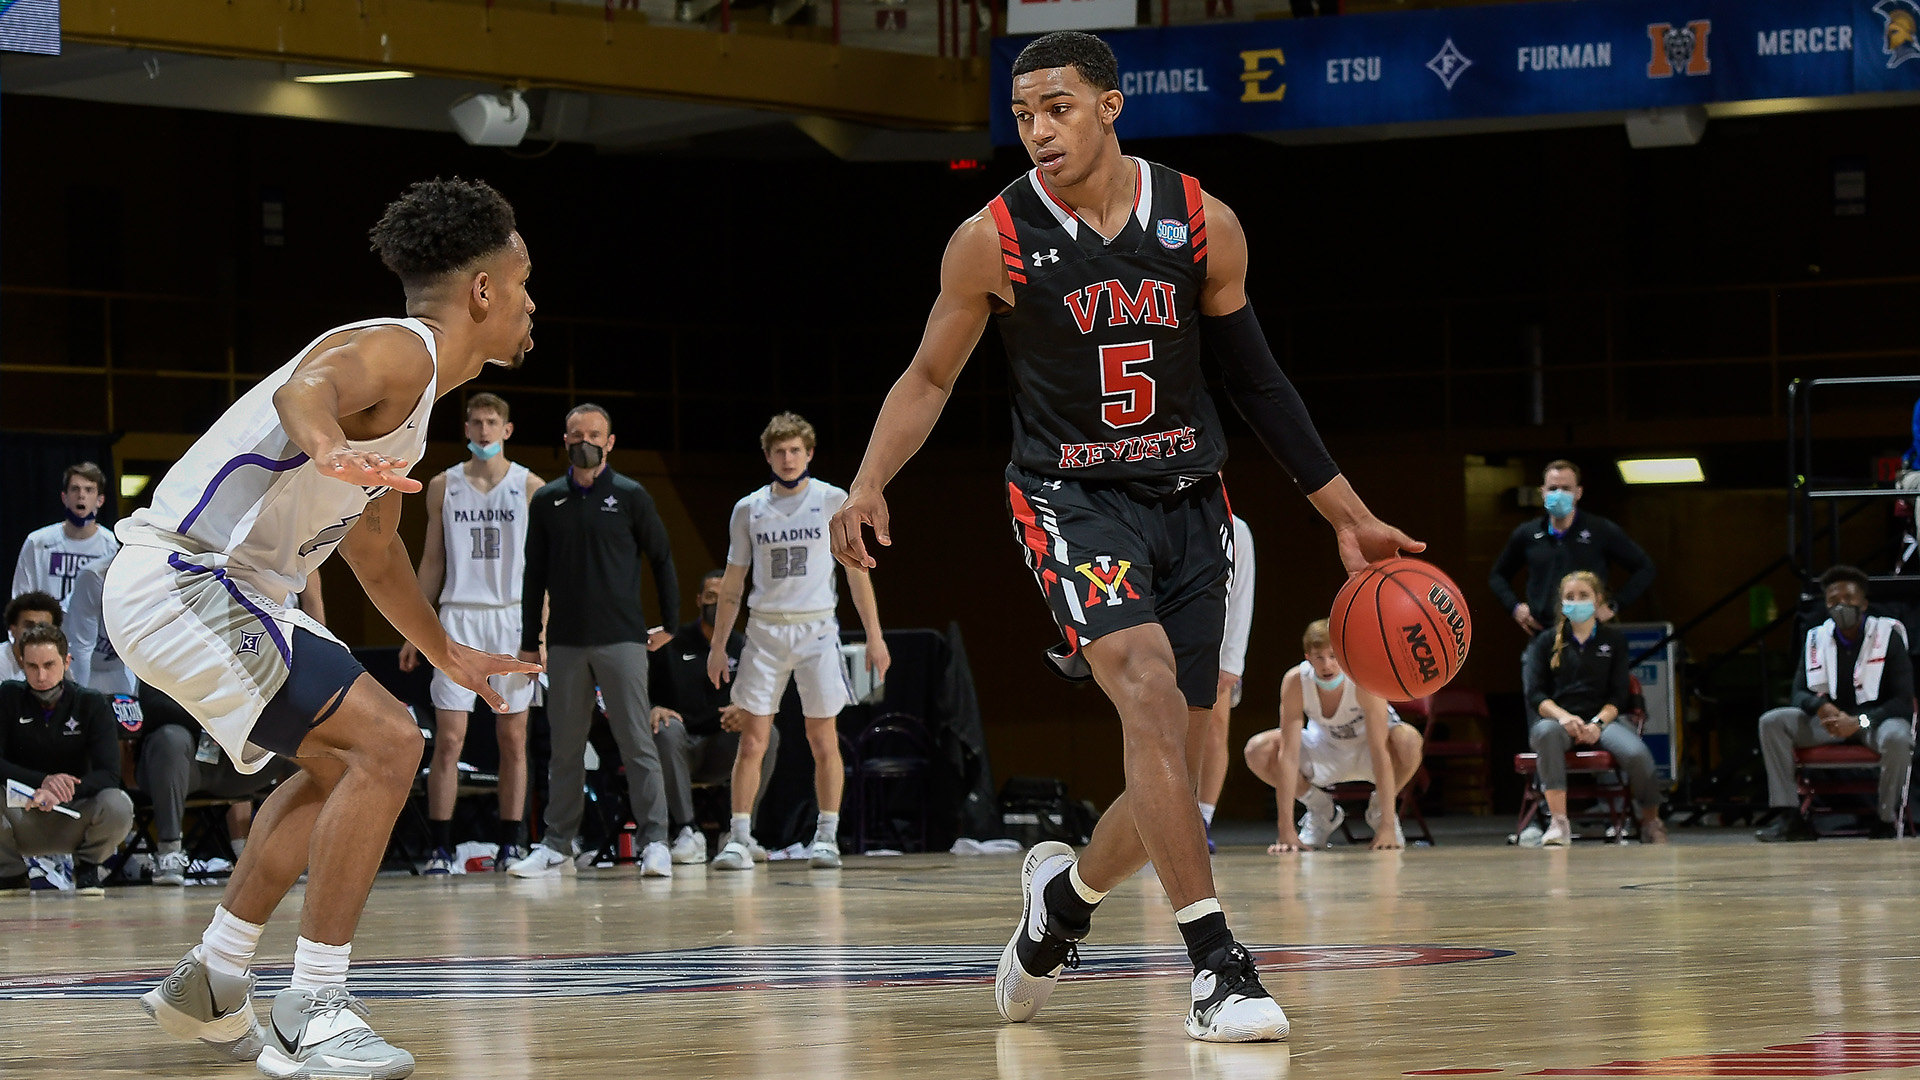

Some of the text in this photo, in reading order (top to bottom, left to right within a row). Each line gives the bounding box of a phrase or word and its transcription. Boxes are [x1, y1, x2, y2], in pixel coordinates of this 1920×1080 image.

[1757, 25, 1852, 56] MERCER
[1326, 57, 1382, 84] ETSU
[1517, 42, 1612, 72] FURMAN
[1122, 68, 1209, 96] CITADEL
[1157, 219, 1188, 243] SOCON
[1064, 279, 1179, 334] VMI
[1098, 340, 1156, 429] 5
[1059, 427, 1197, 468] KEYDETS
[454, 509, 515, 523] PALADINS
[470, 527, 501, 560] 12
[756, 527, 822, 545] PALADINS
[770, 546, 808, 580] 22
[1402, 623, 1440, 684] NCAA
